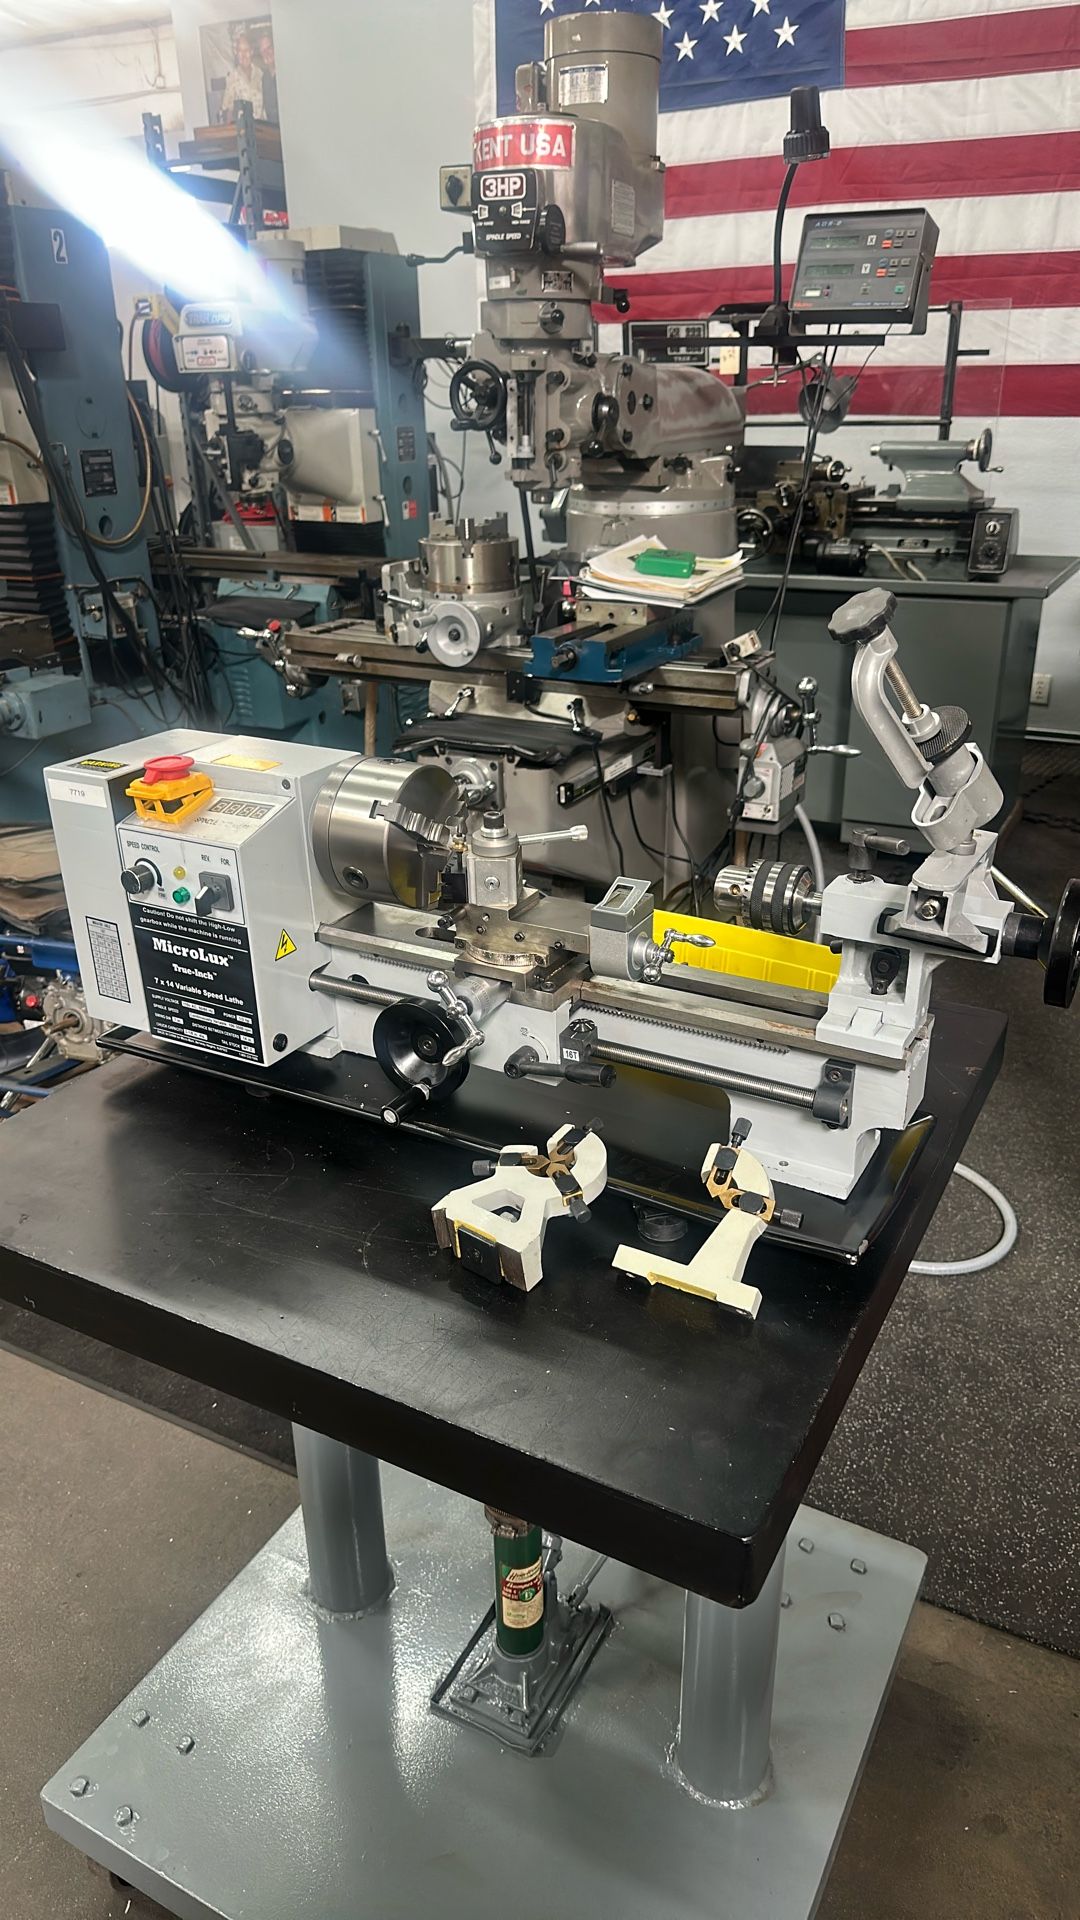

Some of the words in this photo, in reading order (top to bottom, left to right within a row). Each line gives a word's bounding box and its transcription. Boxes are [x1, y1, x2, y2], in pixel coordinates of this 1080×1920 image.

[519, 132, 567, 157] USA
[485, 177, 521, 197] 3HP
[52, 230, 67, 262] 2
[126, 840, 140, 849] SPEED
[140, 843, 160, 853] CONTROL
[140, 917, 162, 927] gearbox
[163, 921, 178, 929] while
[178, 924, 188, 932] the
[188, 927, 212, 938] machine
[218, 933, 242, 945] running
[142, 907, 166, 917] Caution!
[166, 911, 175, 919] Do
[185, 916, 198, 925] shift
[198, 918, 207, 926] the
[208, 921, 236, 933] High-Low
[165, 980, 175, 988] 14
[174, 982, 202, 995] Variable
[202, 986, 224, 1001] Speed
[224, 994, 244, 1006] Lathe
[565, 1050, 577, 1060] 16T
